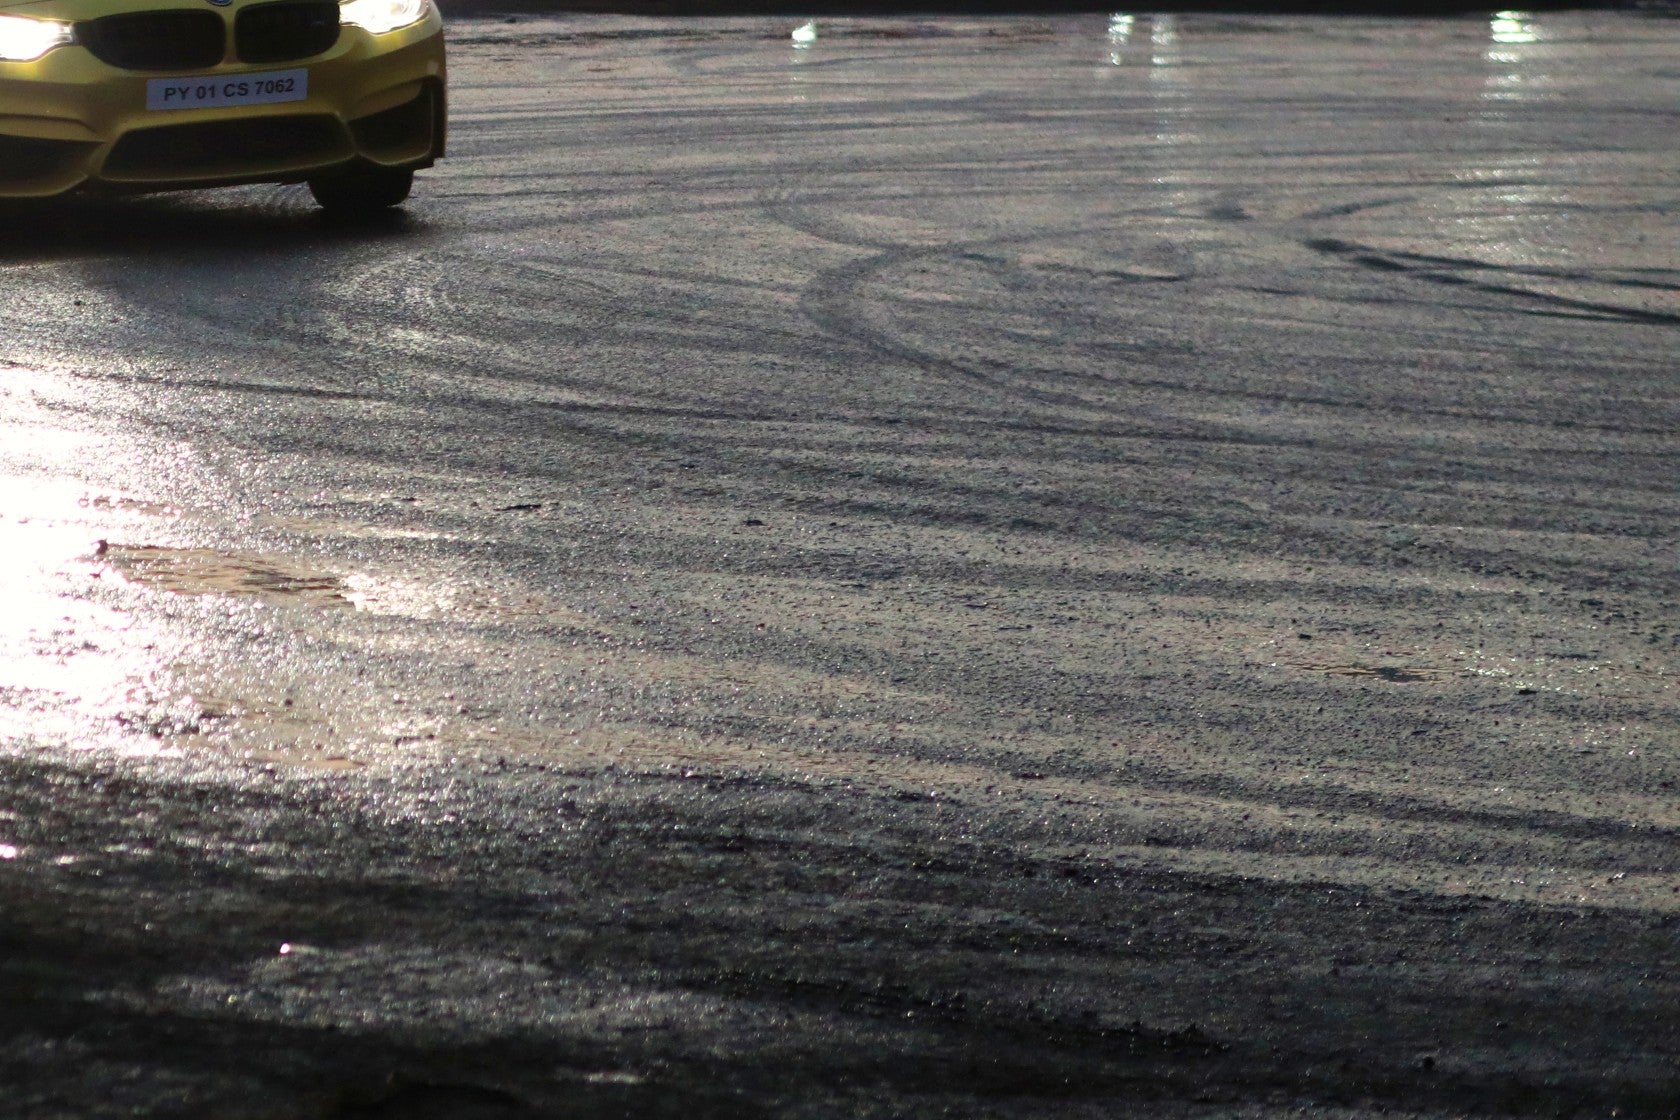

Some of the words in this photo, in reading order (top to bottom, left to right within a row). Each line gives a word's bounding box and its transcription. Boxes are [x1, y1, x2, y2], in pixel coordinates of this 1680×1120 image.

[164, 86, 190, 101] PY
[196, 85, 216, 100] 01
[223, 82, 249, 98] CS
[255, 78, 295, 95] 7062
